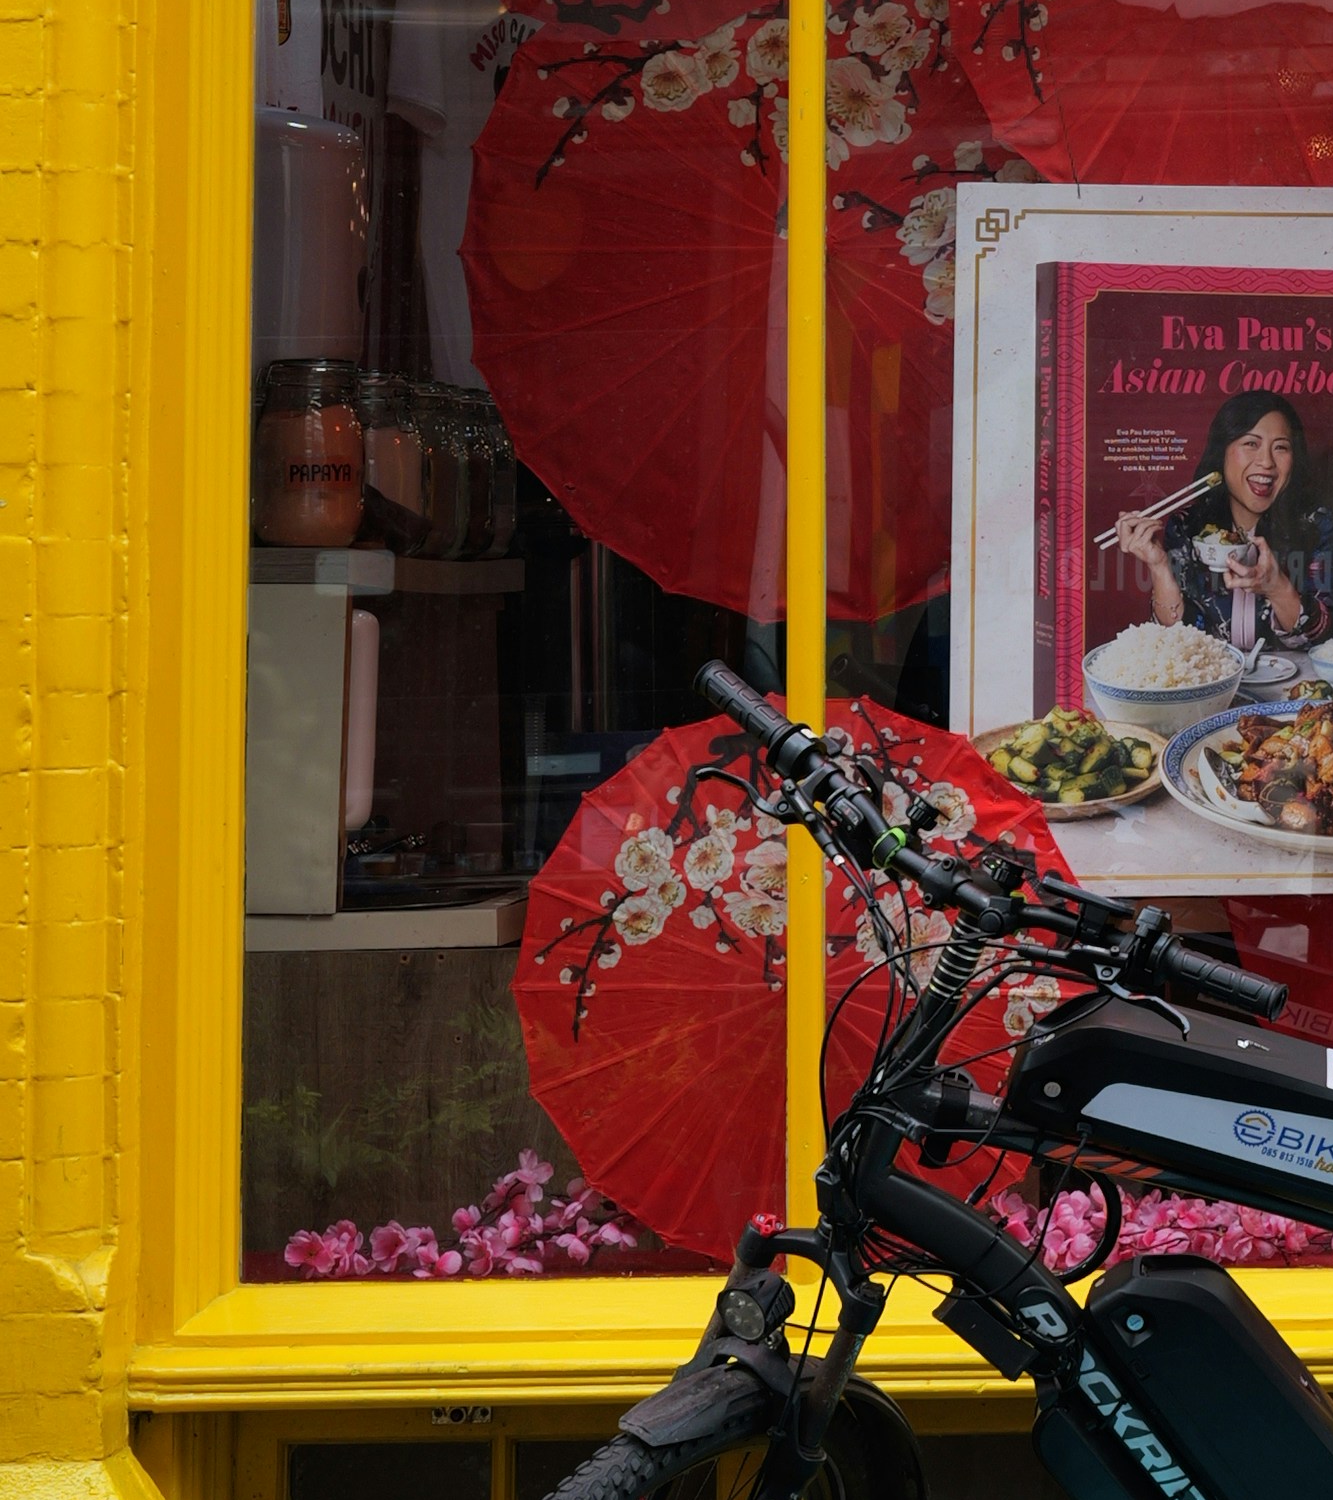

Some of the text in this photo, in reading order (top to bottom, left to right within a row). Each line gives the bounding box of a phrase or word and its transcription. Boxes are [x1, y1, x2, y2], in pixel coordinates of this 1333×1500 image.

[1161, 316, 1332, 350] Eva Pau's
[1098, 358, 1207, 394] Asian
[289, 463, 352, 482] PAPAYA
[1261, 1146, 1315, 1169] 085 813 1518
